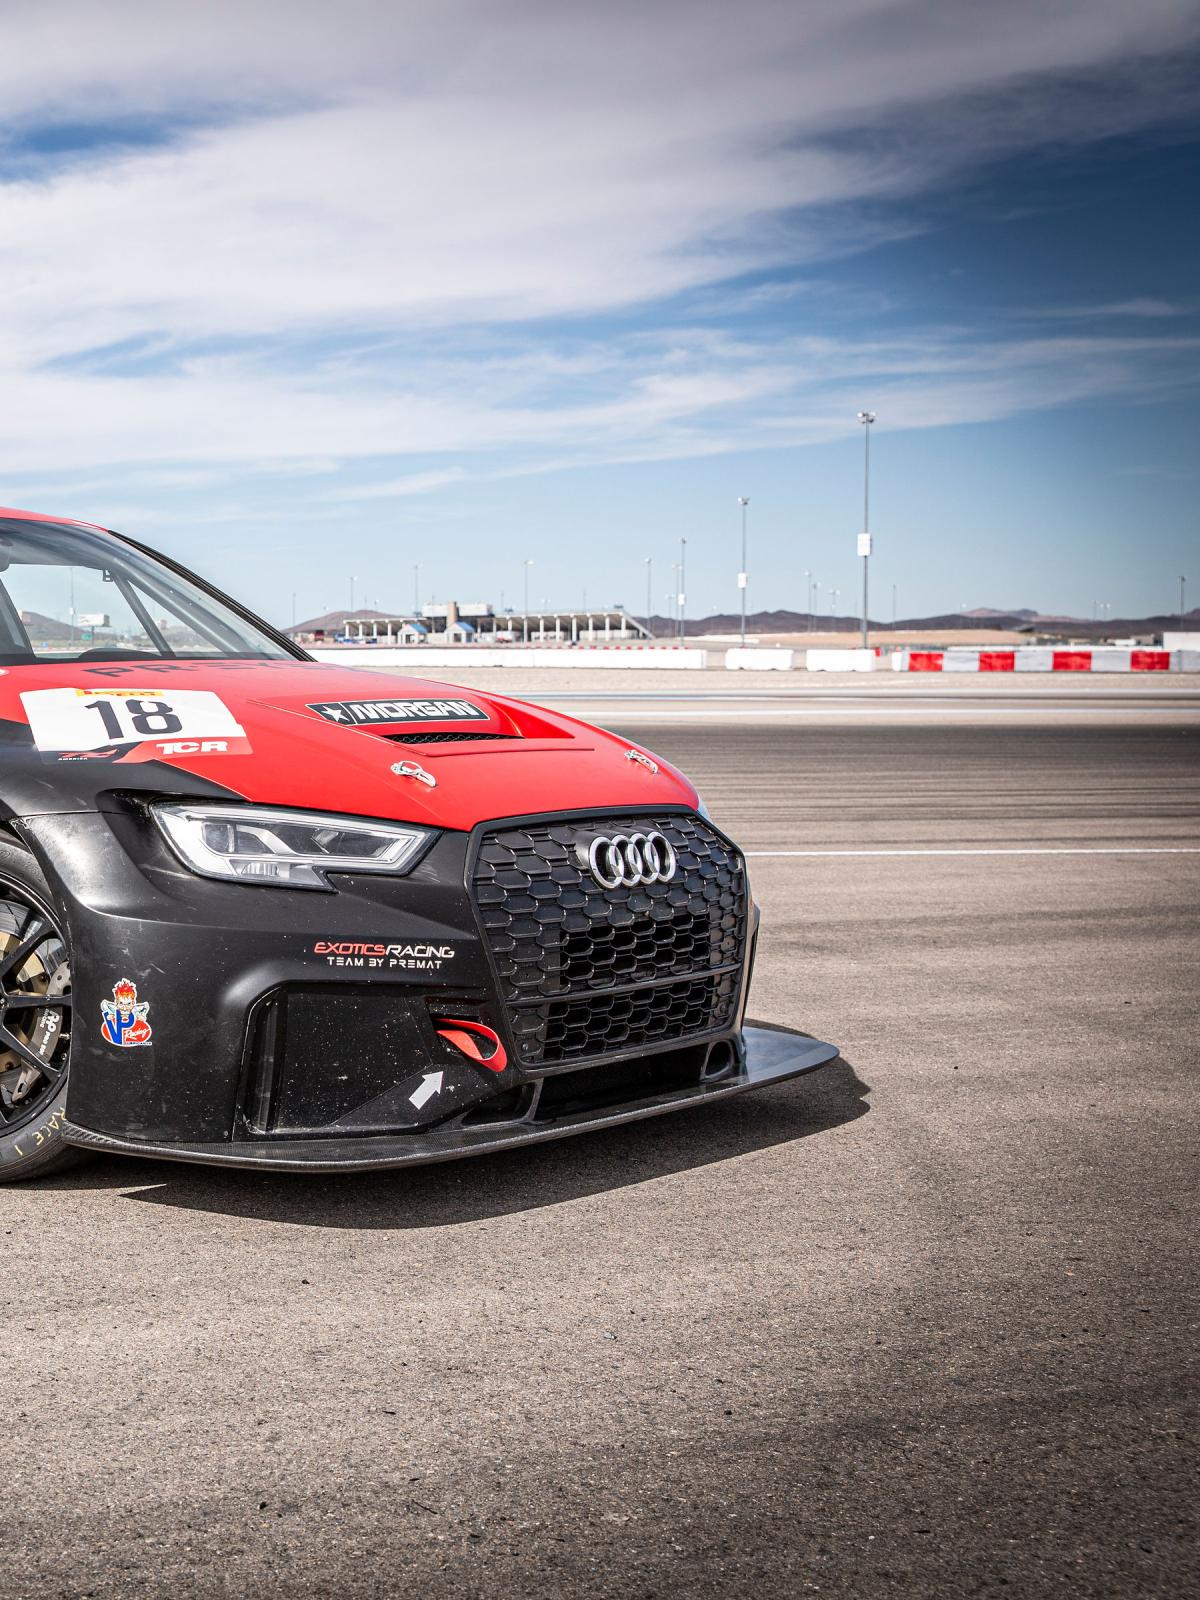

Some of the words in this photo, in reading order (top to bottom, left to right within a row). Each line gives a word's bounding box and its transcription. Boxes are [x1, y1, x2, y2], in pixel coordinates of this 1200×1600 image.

[349, 702, 480, 720] MORGAN
[84, 699, 183, 740] 18
[156, 741, 229, 755] TCR
[327, 956, 364, 967] TEAM
[368, 958, 385, 968] BY
[389, 958, 443, 969] PREMAT
